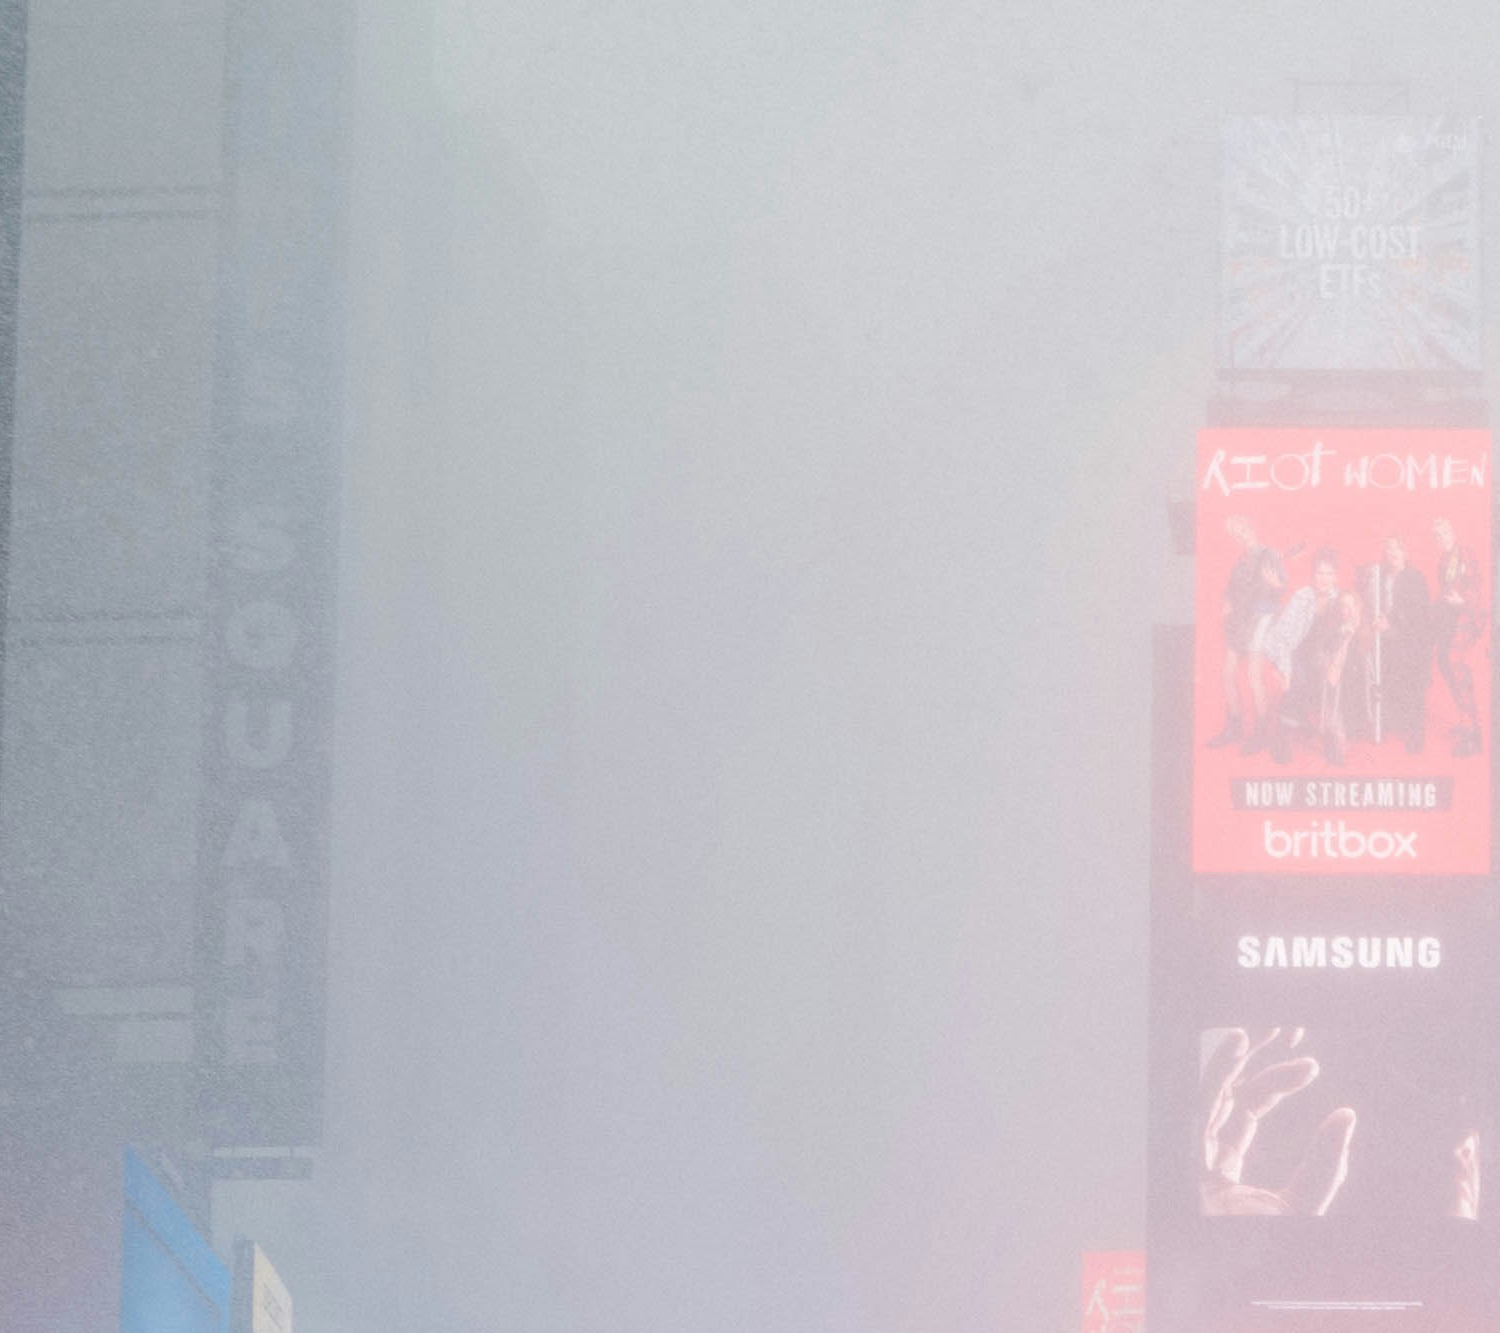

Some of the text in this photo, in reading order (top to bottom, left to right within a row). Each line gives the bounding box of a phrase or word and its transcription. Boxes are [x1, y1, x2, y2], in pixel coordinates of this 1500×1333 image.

[1201, 441, 1488, 496] RIOT WOMEN
[1245, 780, 1438, 809] NOW STREAMING
[1263, 820, 1419, 861] britbox
[1235, 934, 1443, 971] SAMSUNG
